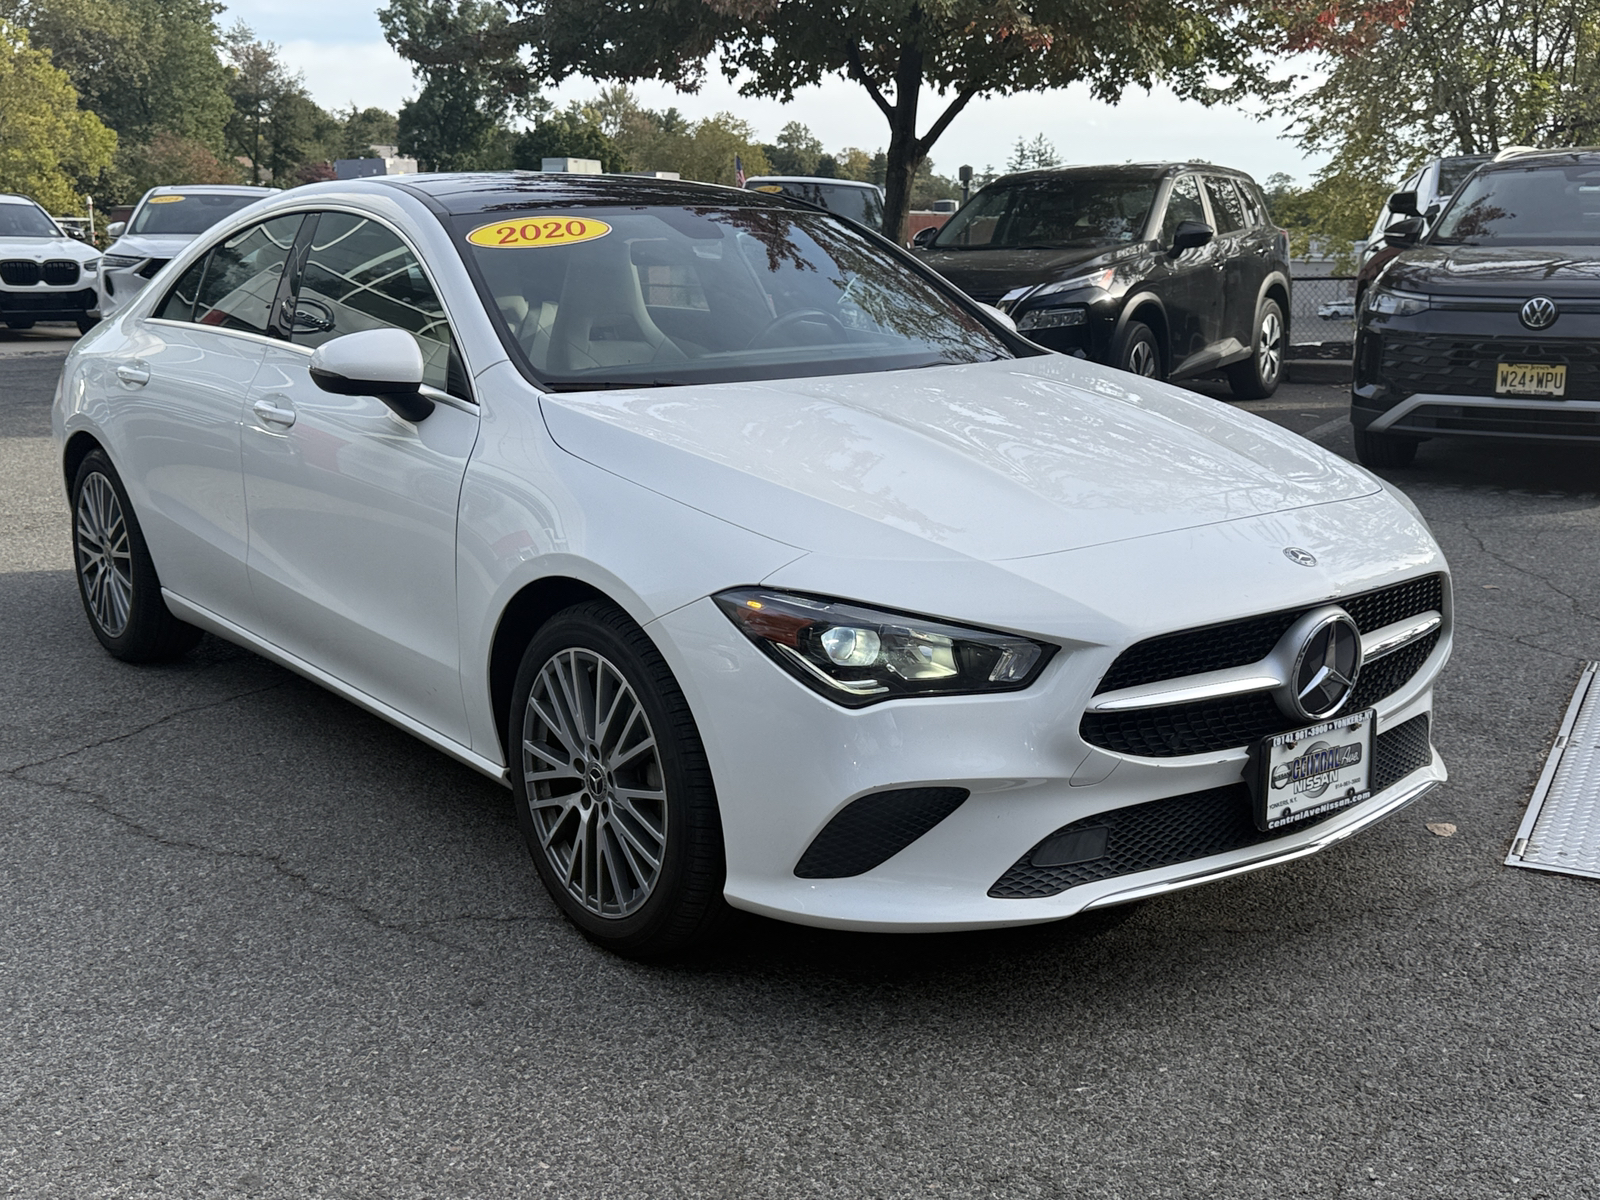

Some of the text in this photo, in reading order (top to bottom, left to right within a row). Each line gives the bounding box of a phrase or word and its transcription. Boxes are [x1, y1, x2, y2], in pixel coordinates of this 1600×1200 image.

[496, 220, 586, 245] 2020
[1292, 746, 1341, 780] CENTRAL
[1293, 769, 1339, 794] NISSAN
